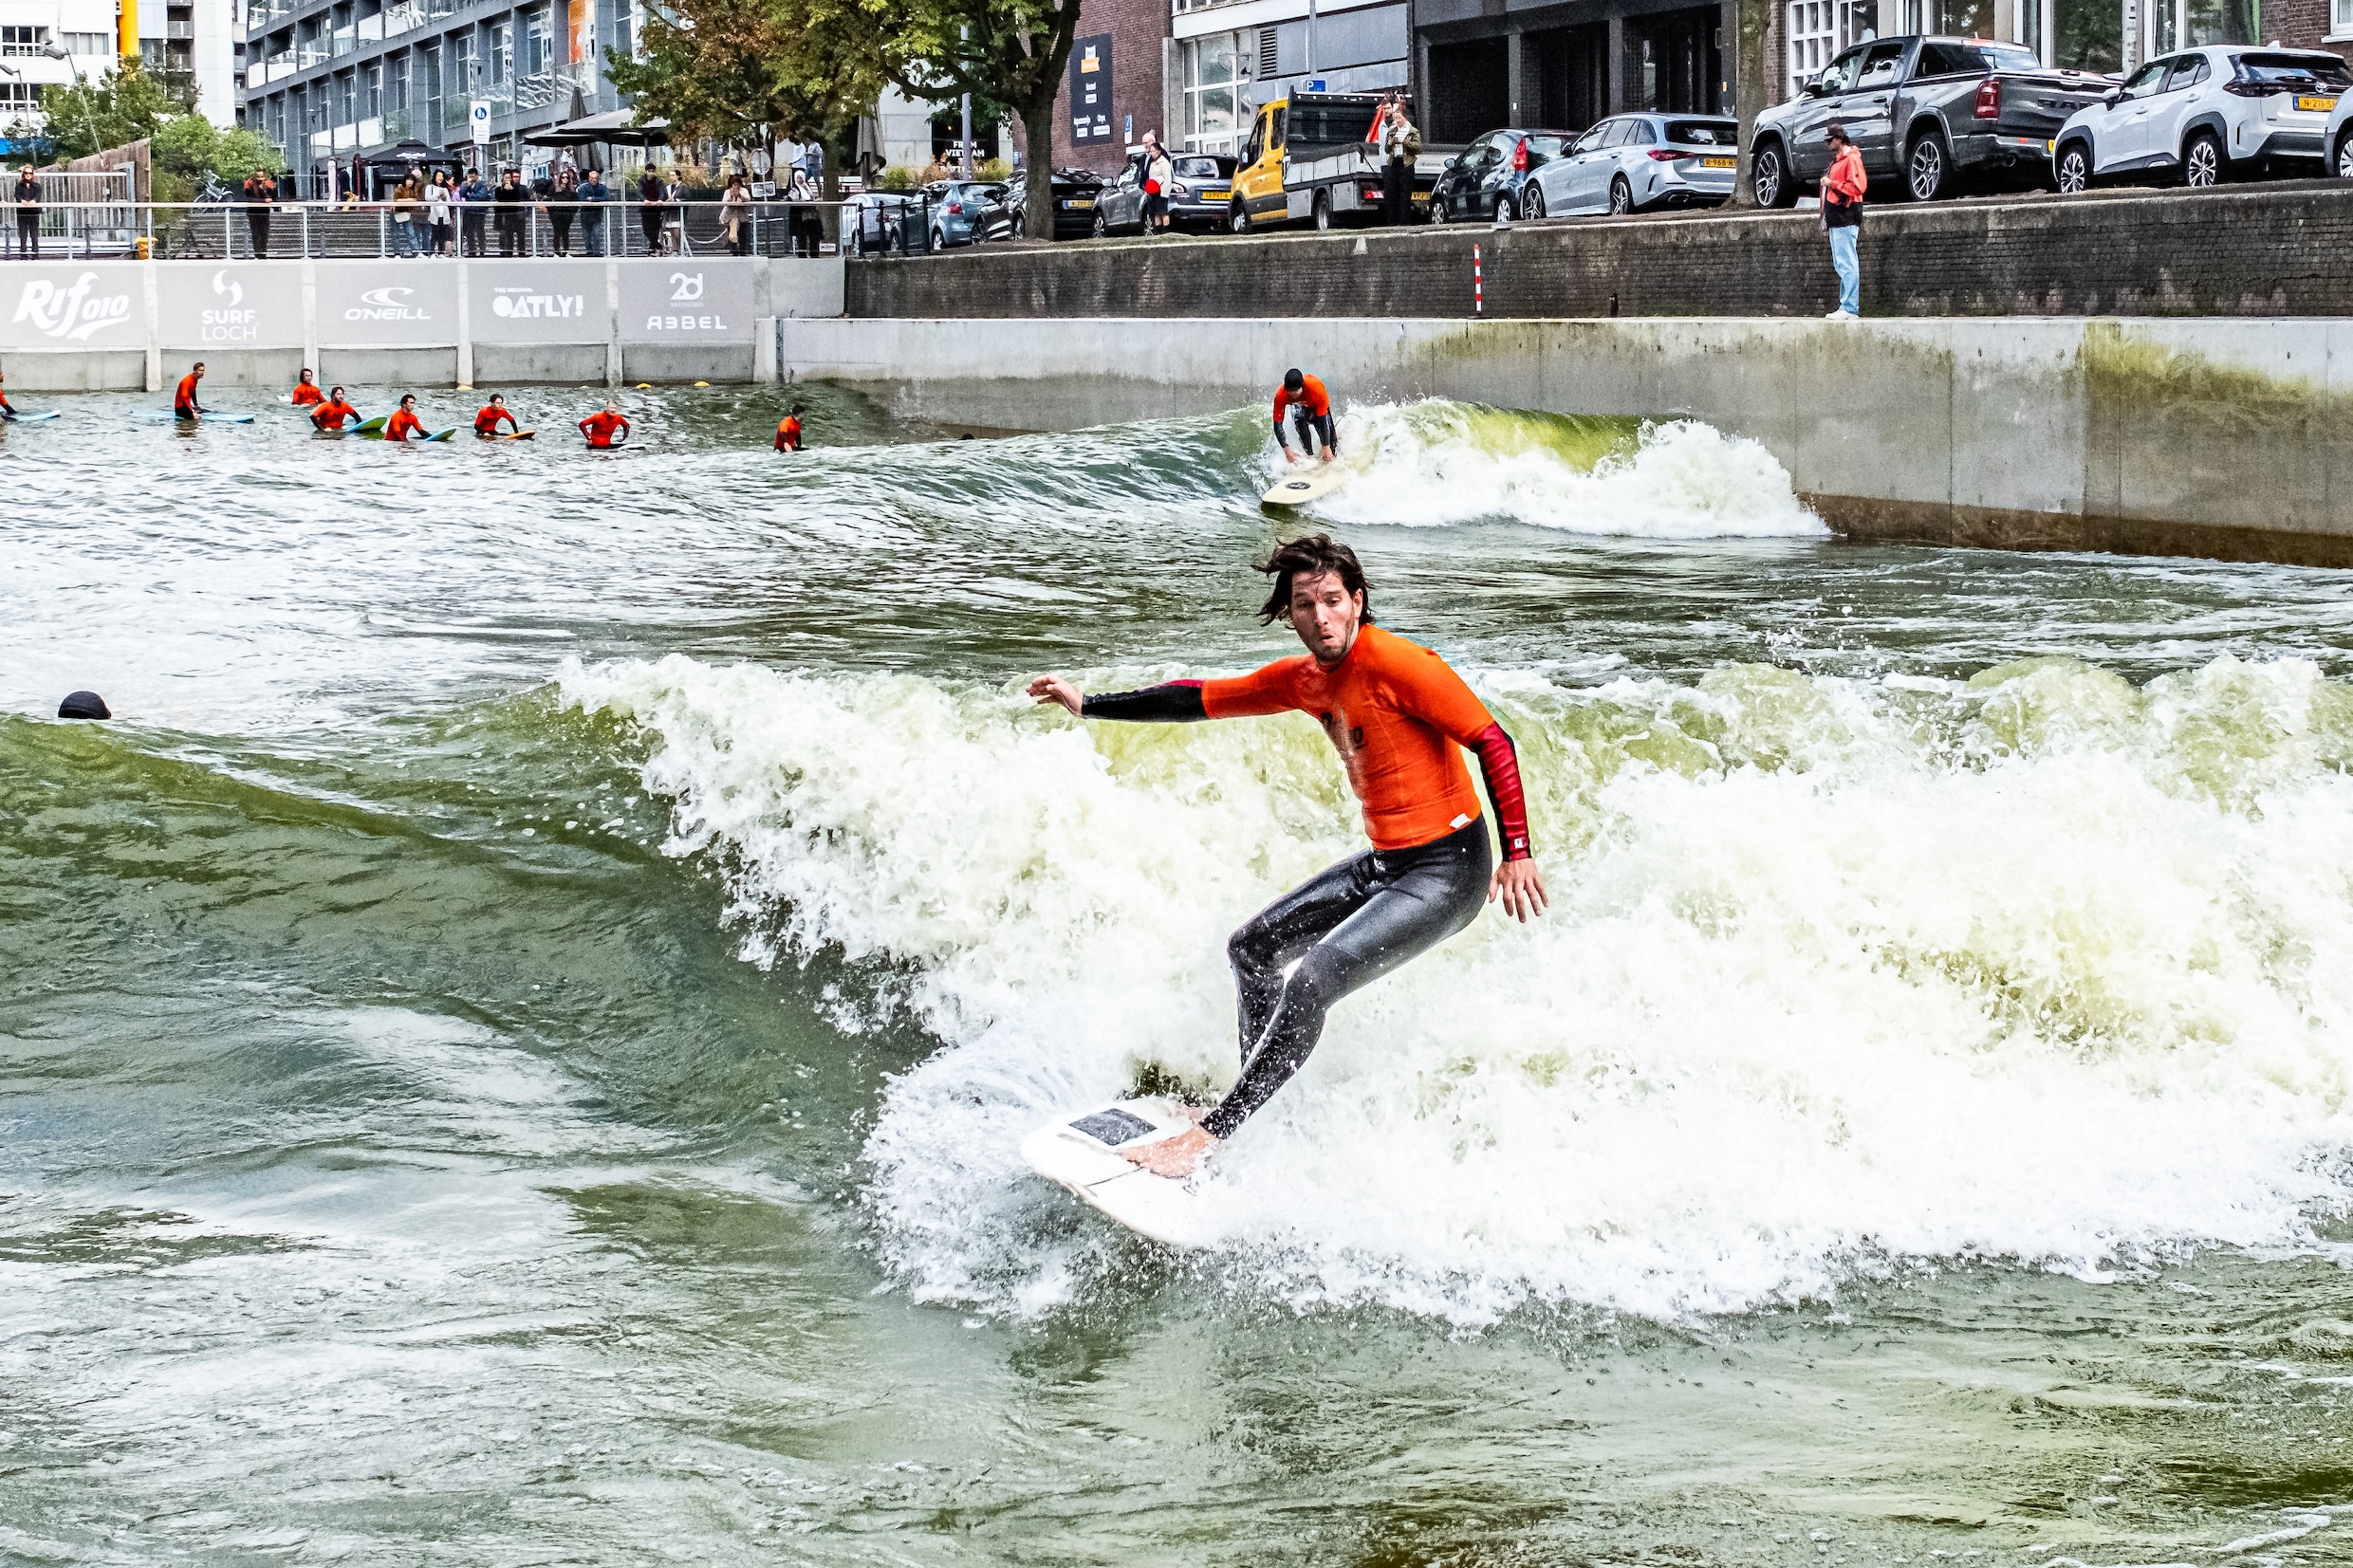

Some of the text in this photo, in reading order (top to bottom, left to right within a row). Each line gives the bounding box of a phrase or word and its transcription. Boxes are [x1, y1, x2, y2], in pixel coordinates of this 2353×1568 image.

[953, 140, 977, 149] FRM
[945, 149, 985, 157] VIETAM
[492, 294, 584, 319] OATLY!
[201, 309, 257, 324] SURF
[201, 325, 257, 341] LOCH
